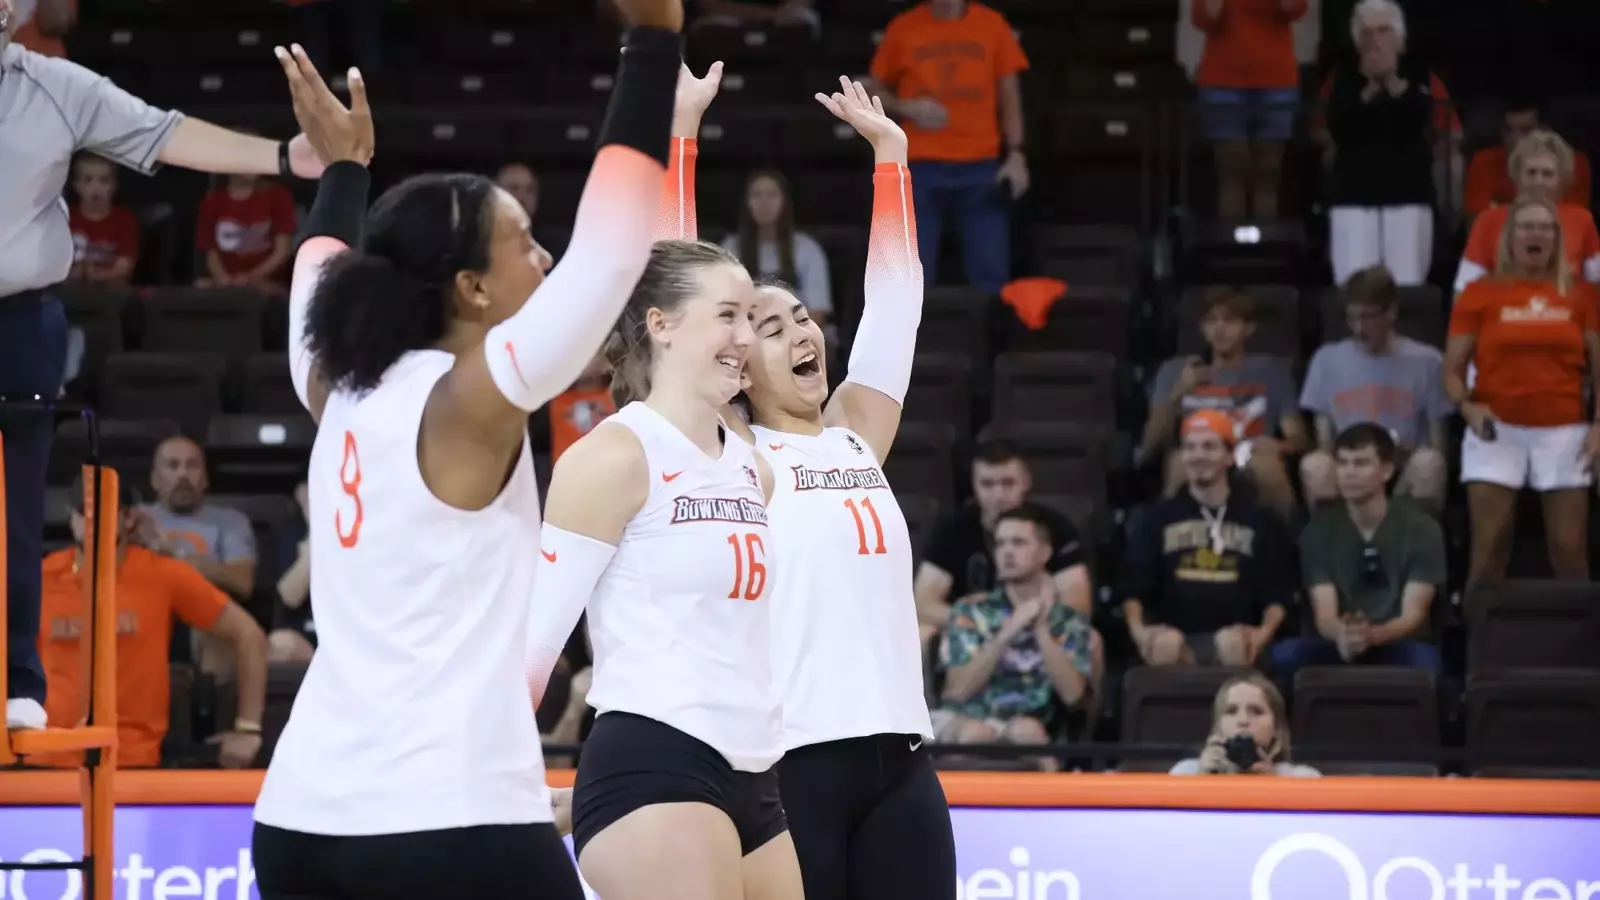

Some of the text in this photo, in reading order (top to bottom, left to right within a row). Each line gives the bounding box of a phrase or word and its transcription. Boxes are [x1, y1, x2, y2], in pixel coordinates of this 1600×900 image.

[335, 430, 362, 548] 9
[671, 496, 739, 524] BOWLING
[843, 496, 887, 555] 11
[727, 533, 766, 600] 16
